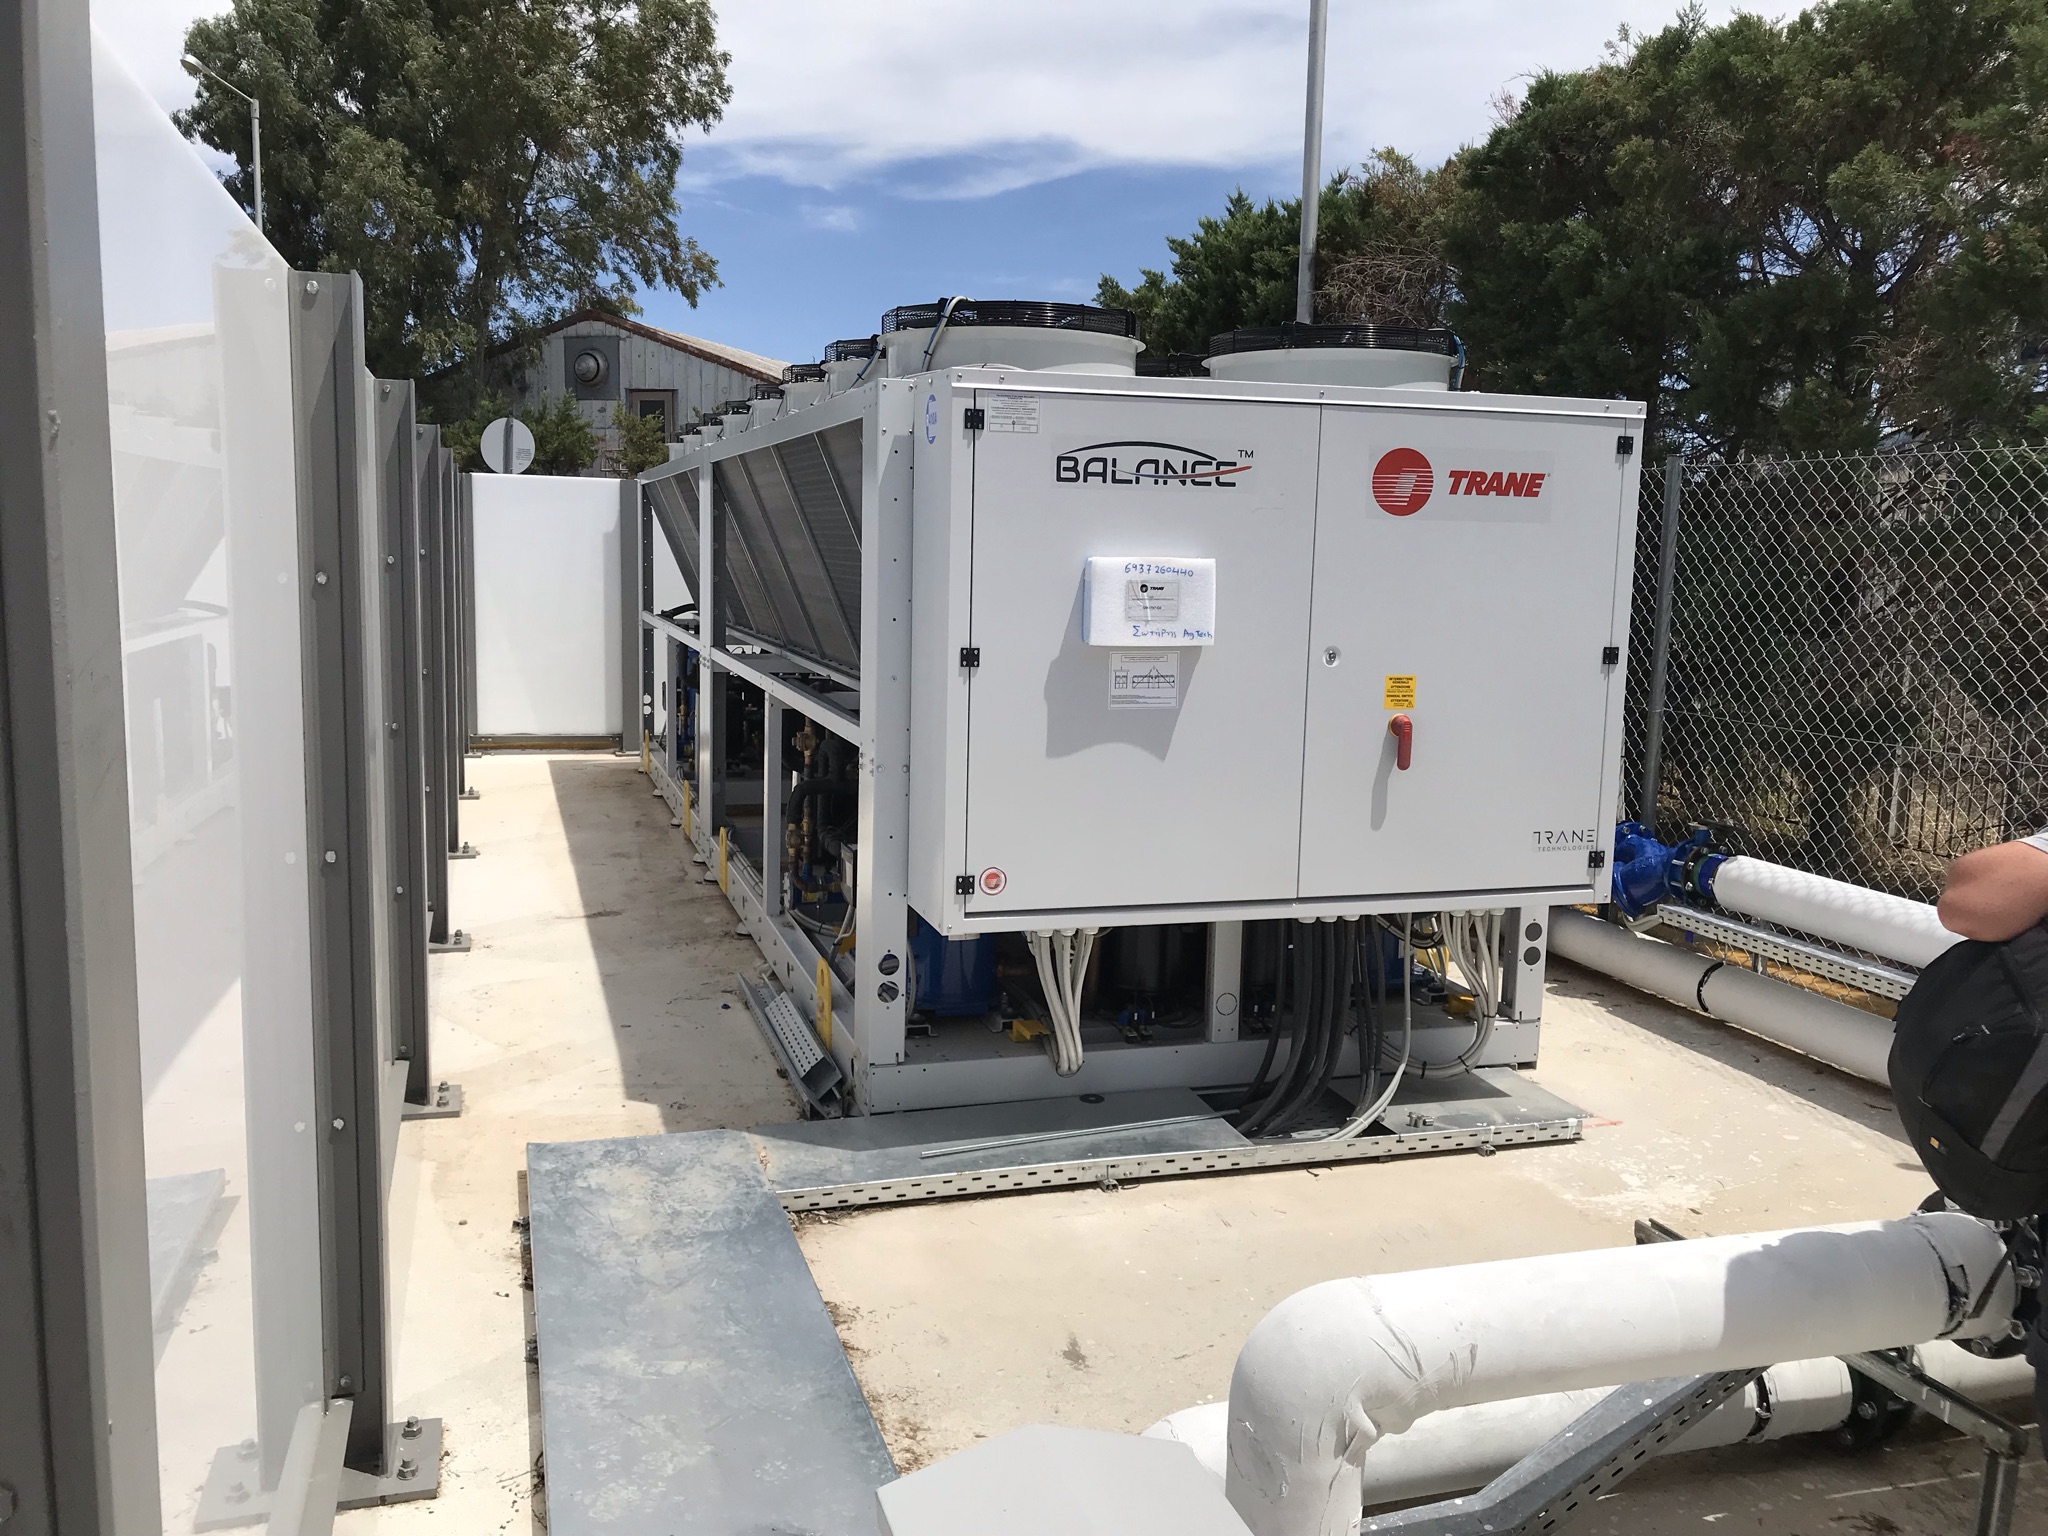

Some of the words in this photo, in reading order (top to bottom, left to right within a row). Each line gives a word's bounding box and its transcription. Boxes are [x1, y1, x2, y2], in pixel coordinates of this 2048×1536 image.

[1056, 455, 1237, 488] BALANCE
[1448, 469, 1547, 498] TRANE
[1533, 829, 1595, 844] TRANE
[1538, 844, 1595, 852] TECHNOLOGIES
